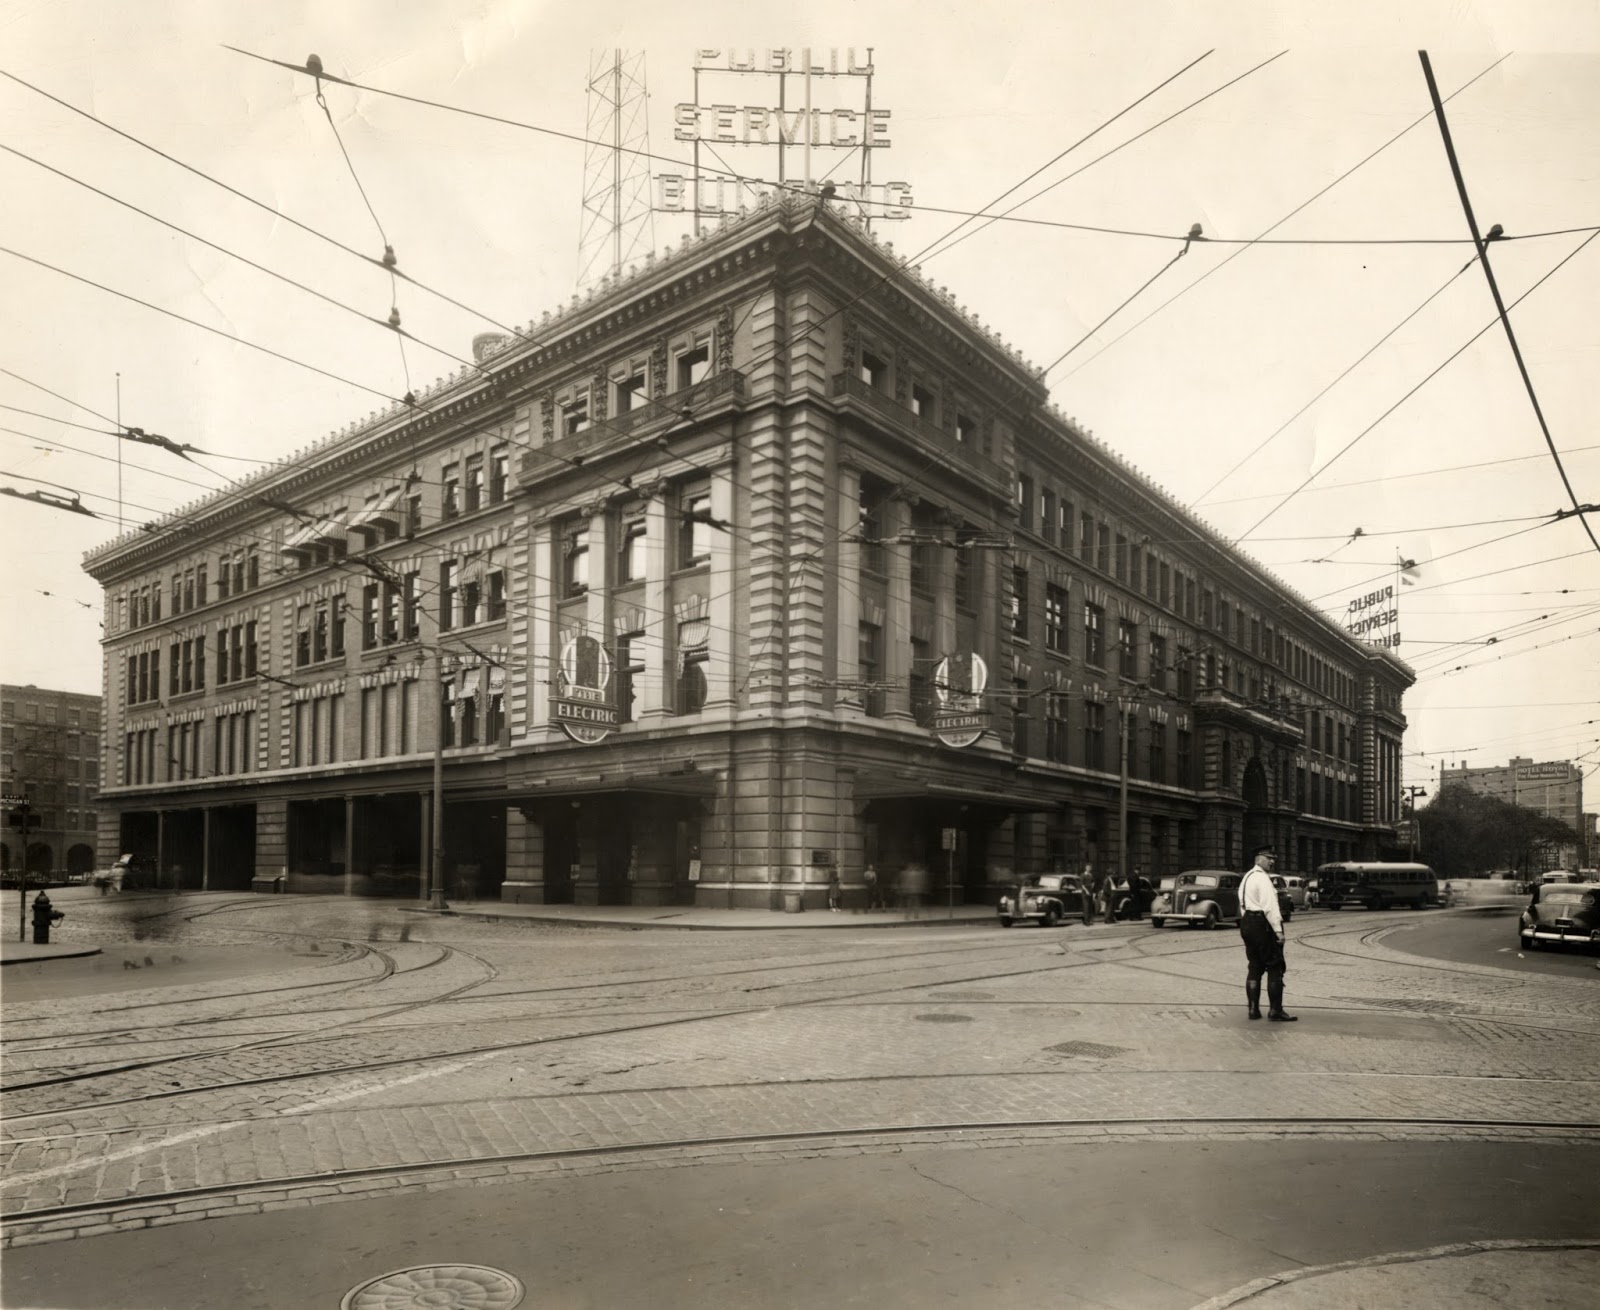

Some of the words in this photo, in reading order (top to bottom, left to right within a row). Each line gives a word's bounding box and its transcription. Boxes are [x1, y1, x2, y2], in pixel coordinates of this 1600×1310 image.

[674, 103, 891, 148] SERVICE
[558, 703, 618, 723] ELECTRIC
[936, 716, 982, 728] ELECTRIC
